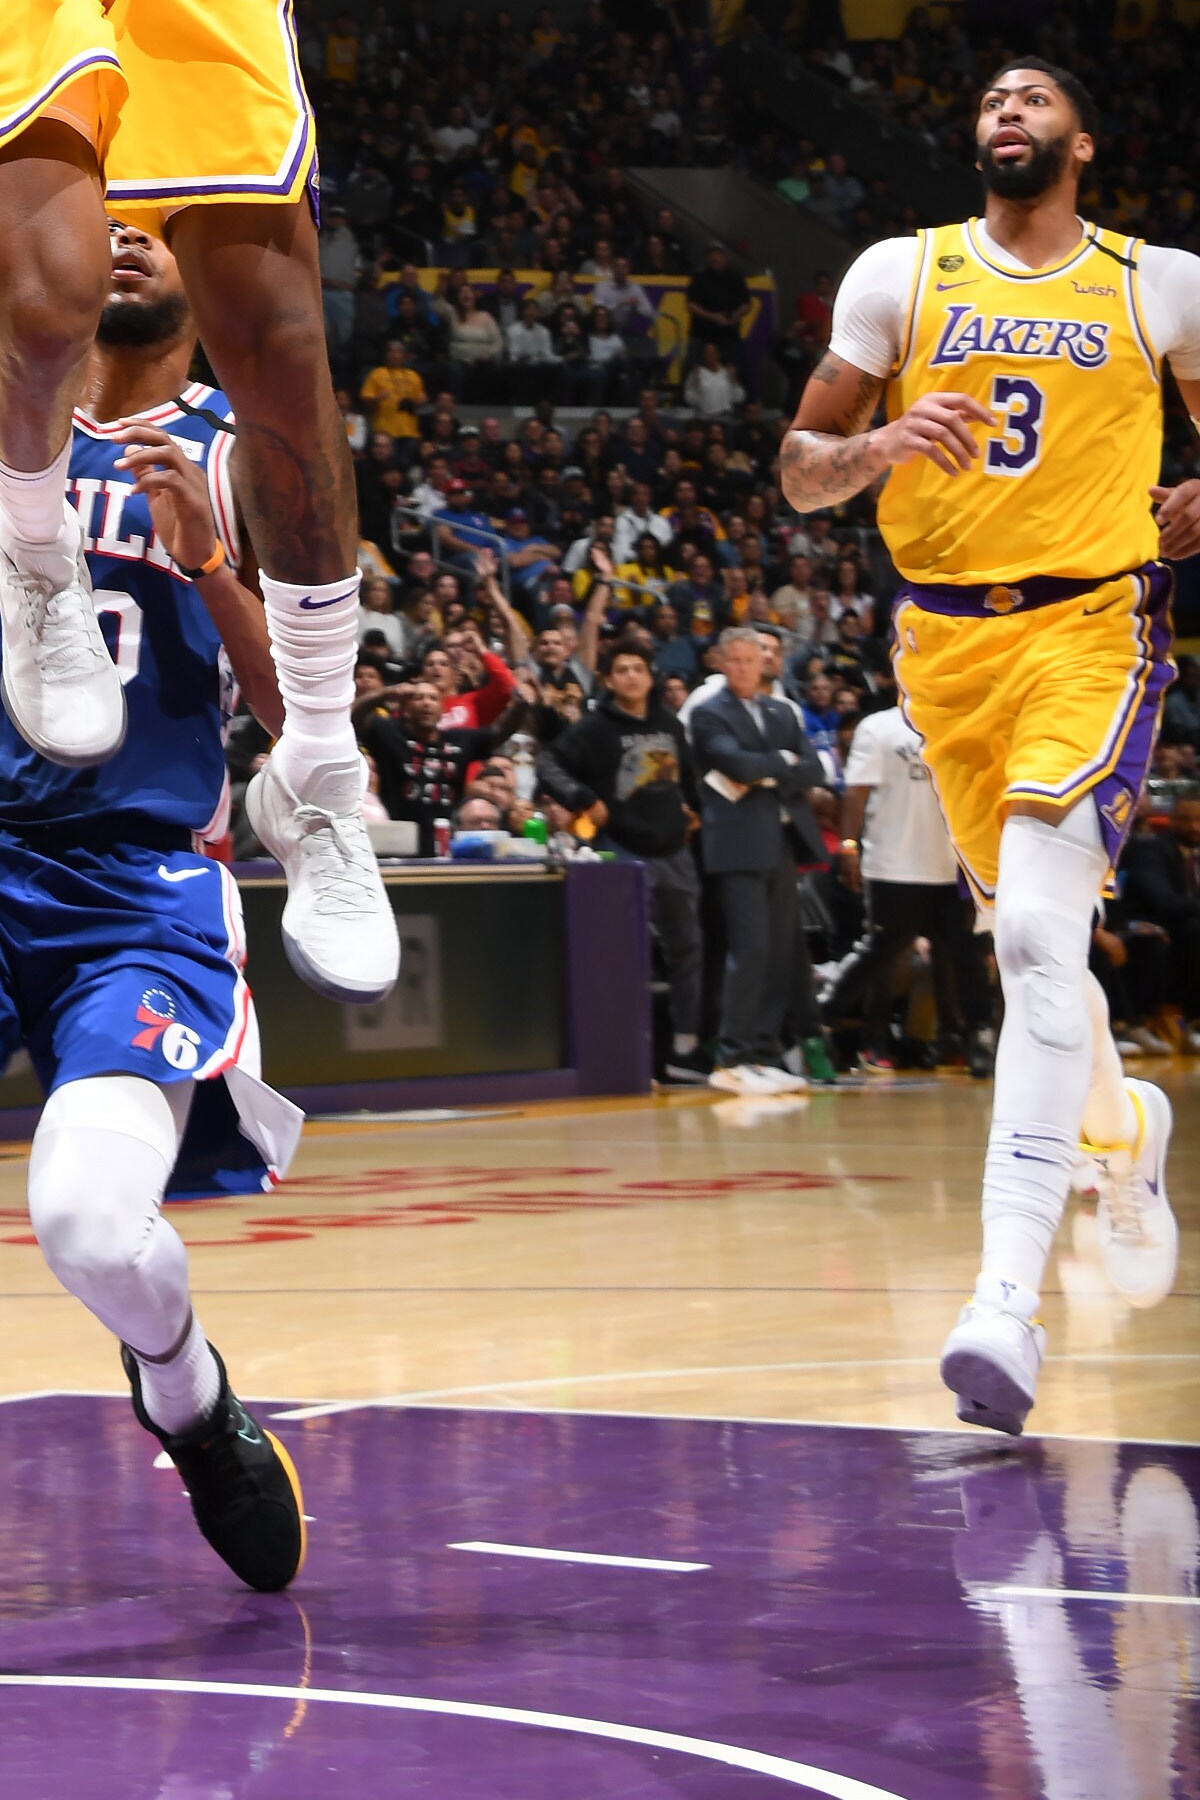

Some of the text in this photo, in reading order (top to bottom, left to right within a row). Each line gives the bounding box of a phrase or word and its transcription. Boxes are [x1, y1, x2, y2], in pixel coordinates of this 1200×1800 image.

[1071, 280, 1118, 298] wish
[928, 304, 1111, 370] LAKERS
[984, 374, 1046, 478] 3
[130, 1004, 202, 1071] 76
